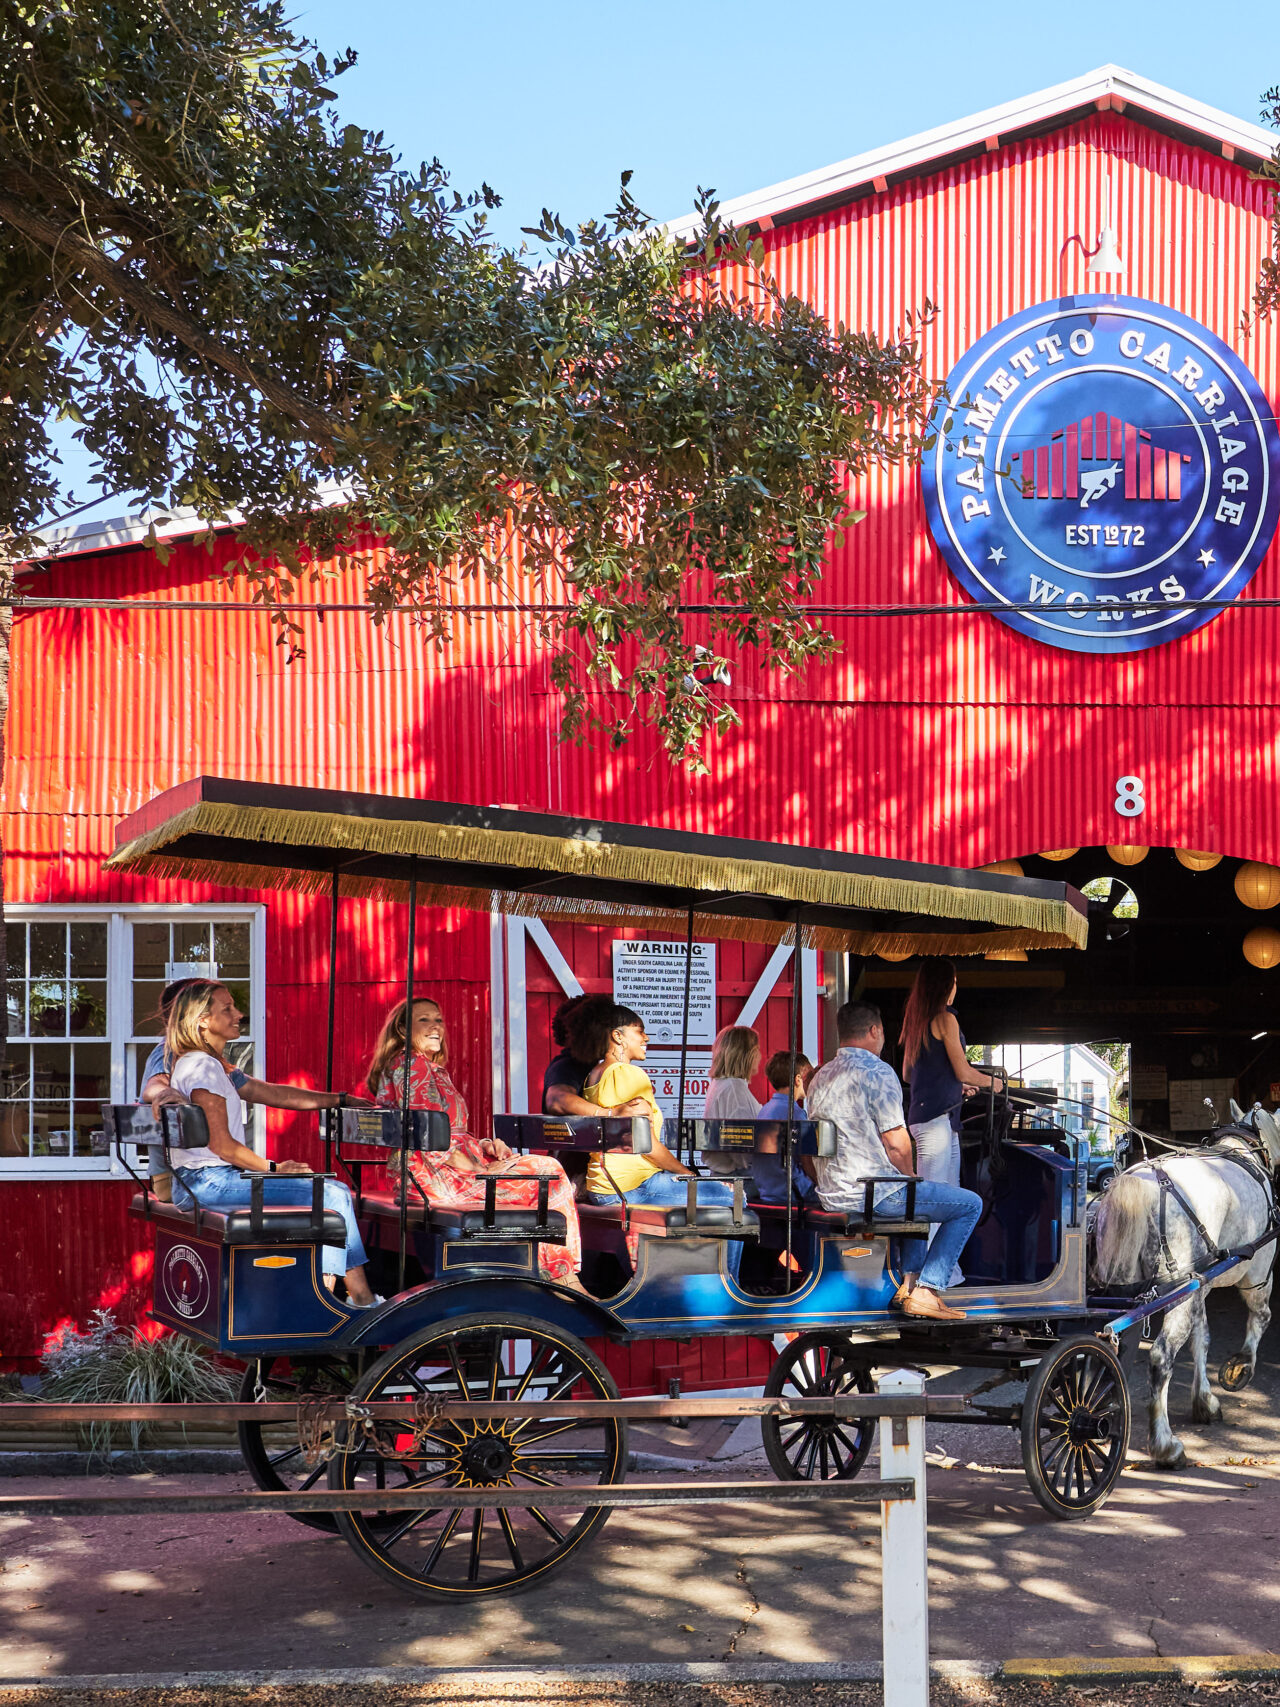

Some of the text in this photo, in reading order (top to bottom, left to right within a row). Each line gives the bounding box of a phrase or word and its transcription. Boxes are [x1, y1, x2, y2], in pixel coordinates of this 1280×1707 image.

[957, 328, 1249, 526] PALMETTO CARRIAGE
[1066, 524, 1145, 546] EST 1972
[1028, 574, 1186, 622] WORKS
[1114, 776, 1146, 817] 8
[626, 942, 702, 955] WARNING
[663, 1080, 673, 1095] &
[684, 1080, 710, 1095] HOR
